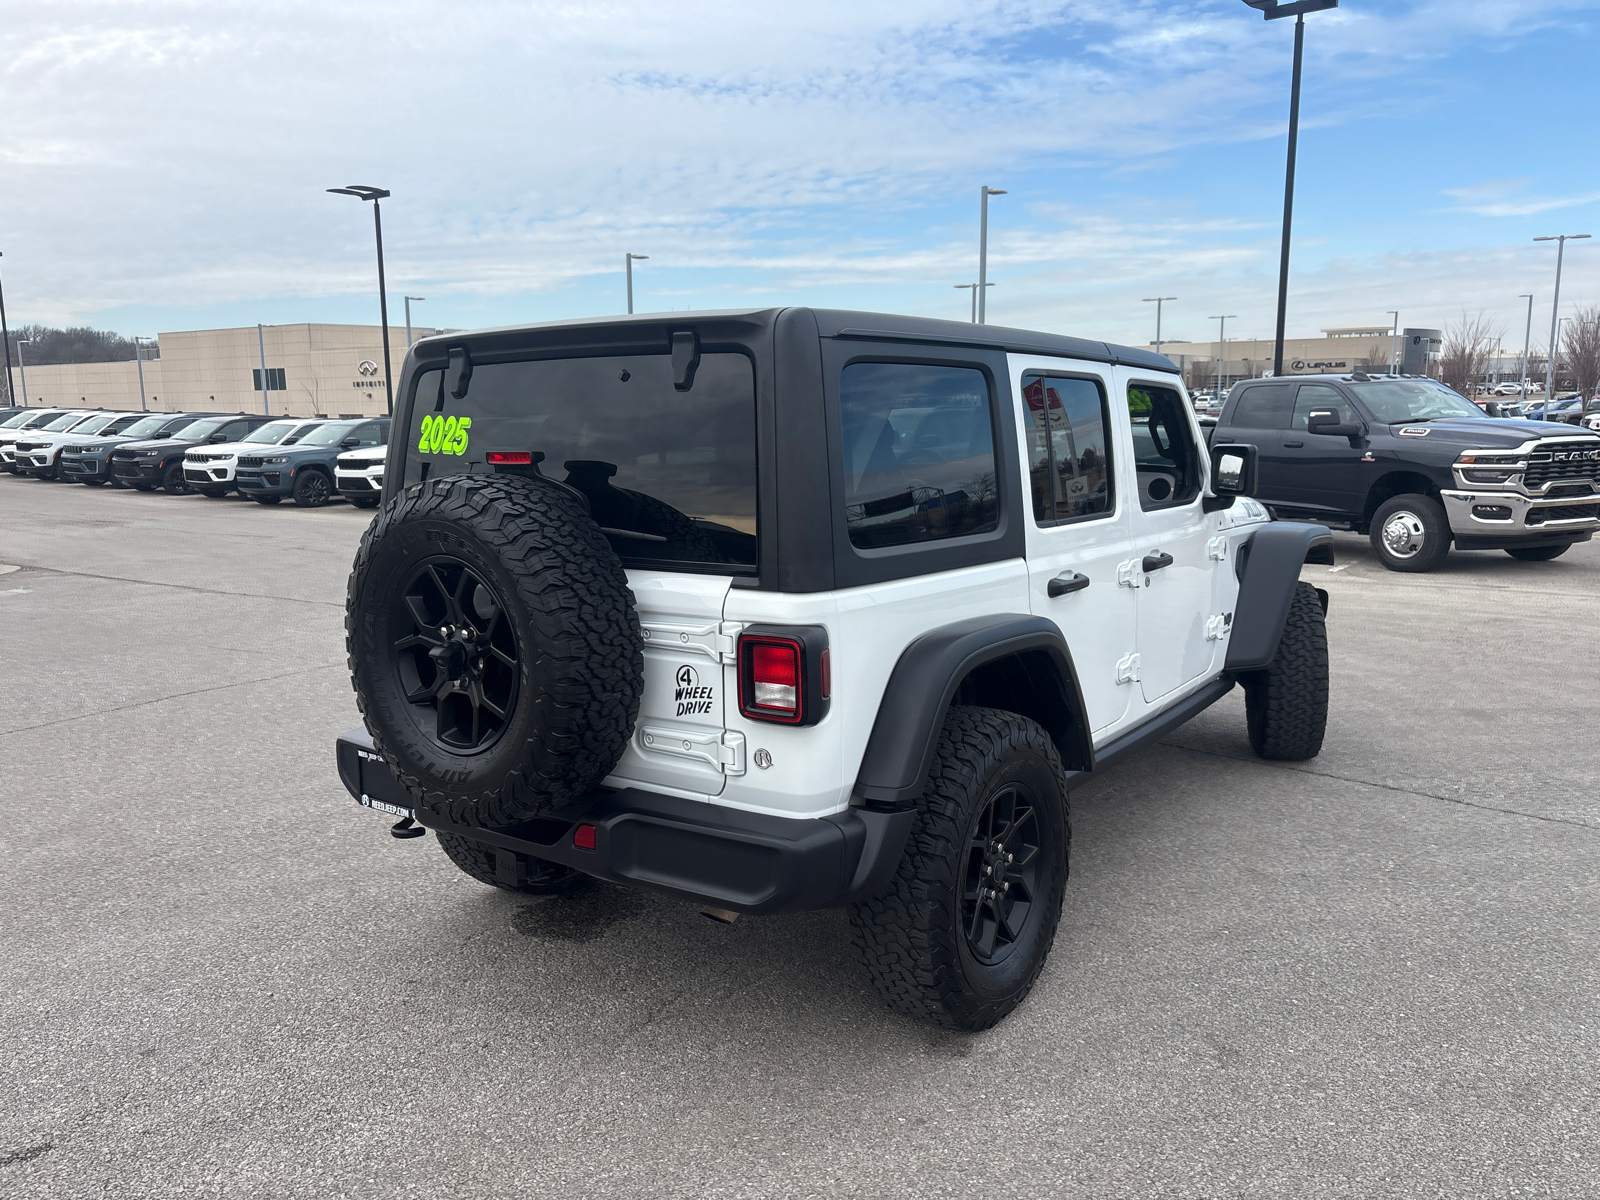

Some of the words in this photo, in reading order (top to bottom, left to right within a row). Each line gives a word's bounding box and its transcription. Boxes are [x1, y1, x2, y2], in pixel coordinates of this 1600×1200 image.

[1307, 361, 1347, 369] LEXUS
[418, 414, 472, 456] 2025
[1554, 451, 1598, 461] RAM
[674, 686, 713, 701] WHEEL
[676, 700, 713, 717] DRIVE
